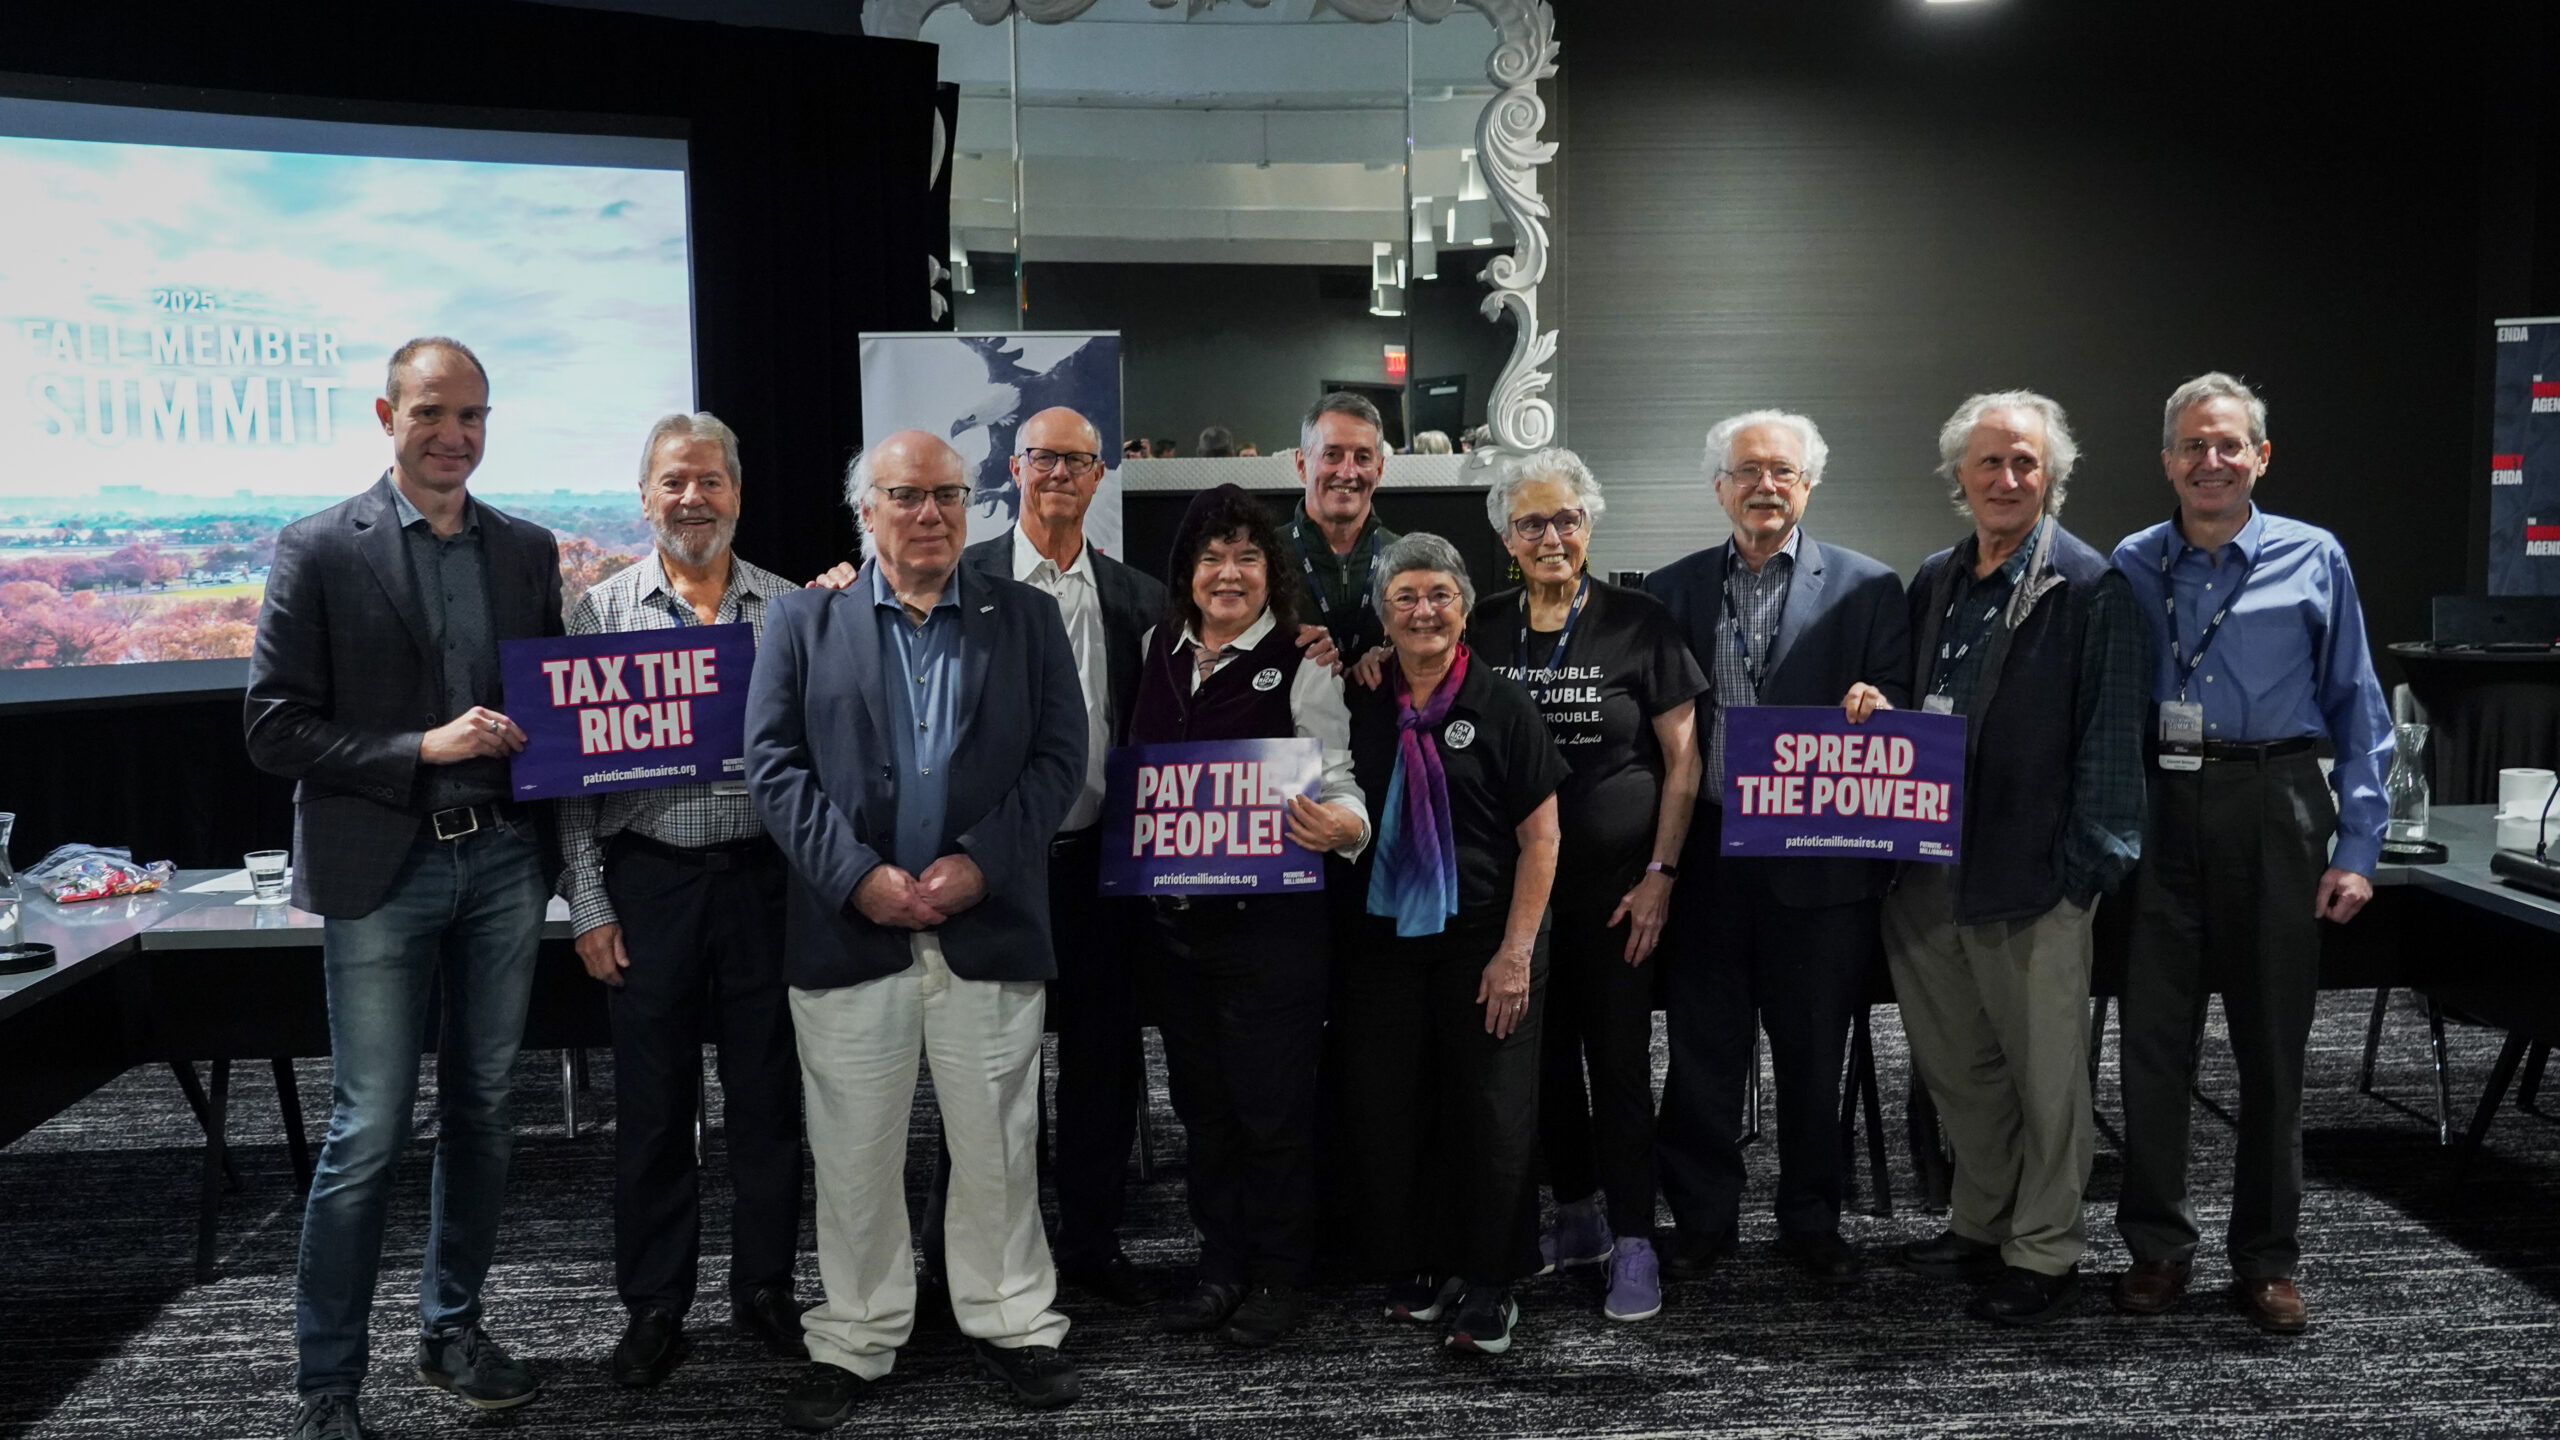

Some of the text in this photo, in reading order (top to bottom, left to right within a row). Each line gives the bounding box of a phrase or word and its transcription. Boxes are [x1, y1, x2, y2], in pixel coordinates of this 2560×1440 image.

[155, 291, 216, 313] 2025
[24, 321, 342, 366] FALL MEMBER
[31, 374, 341, 444] SUMMIT
[542, 648, 719, 707] TAX THE
[579, 701, 695, 755] RICH!
[1569, 732, 1602, 744] Lewis
[583, 764, 697, 786] patrioticmillionaires.org
[1773, 733, 1914, 776] SPREAD
[1136, 761, 1283, 809] PAY THE
[1737, 775, 1951, 822] THE POWER!
[1132, 810, 1283, 857] PEOPLE!
[1786, 836, 1894, 852] patrioticmillionaires.org
[1154, 873, 1258, 887] patrioticmillionaires.org
